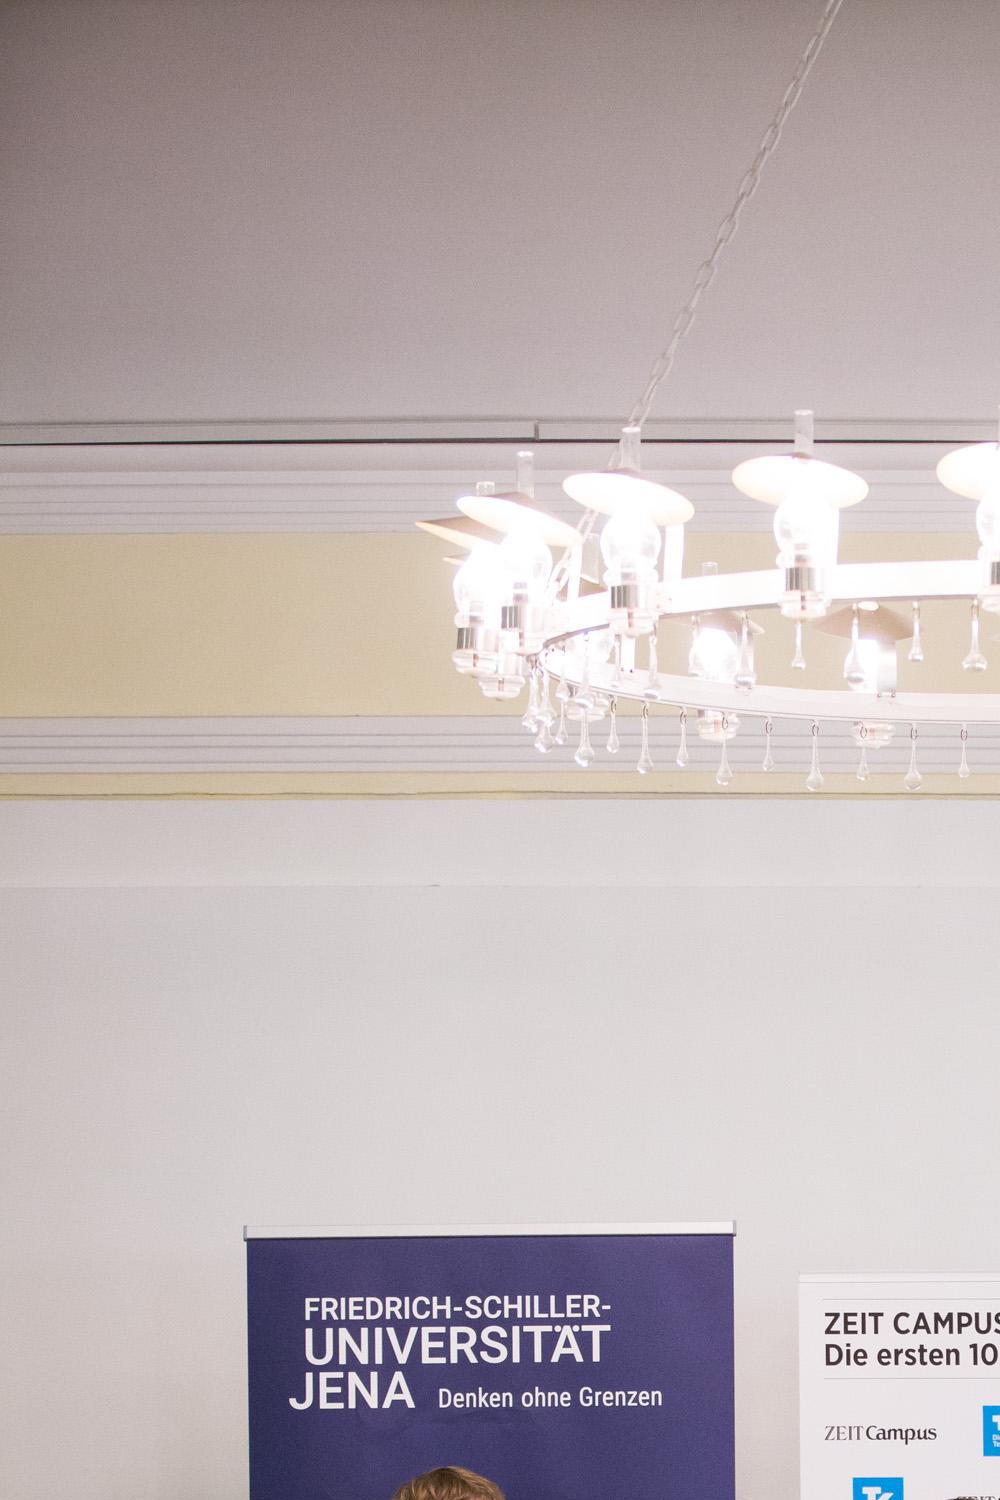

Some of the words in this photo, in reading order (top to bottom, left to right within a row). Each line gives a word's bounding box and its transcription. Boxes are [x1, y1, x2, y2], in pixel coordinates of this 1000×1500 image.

[304, 1295, 611, 1320] FRIEDRICH-SCHILLER-
[825, 1312, 884, 1335] ZEIT
[304, 1324, 611, 1365] UNIVERSITÄT
[825, 1343, 867, 1366] Die
[877, 1344, 960, 1366] ersten
[289, 1371, 415, 1410] JENA
[438, 1387, 513, 1409] Denken
[521, 1387, 571, 1408] ohne
[579, 1386, 663, 1407] Grenzen
